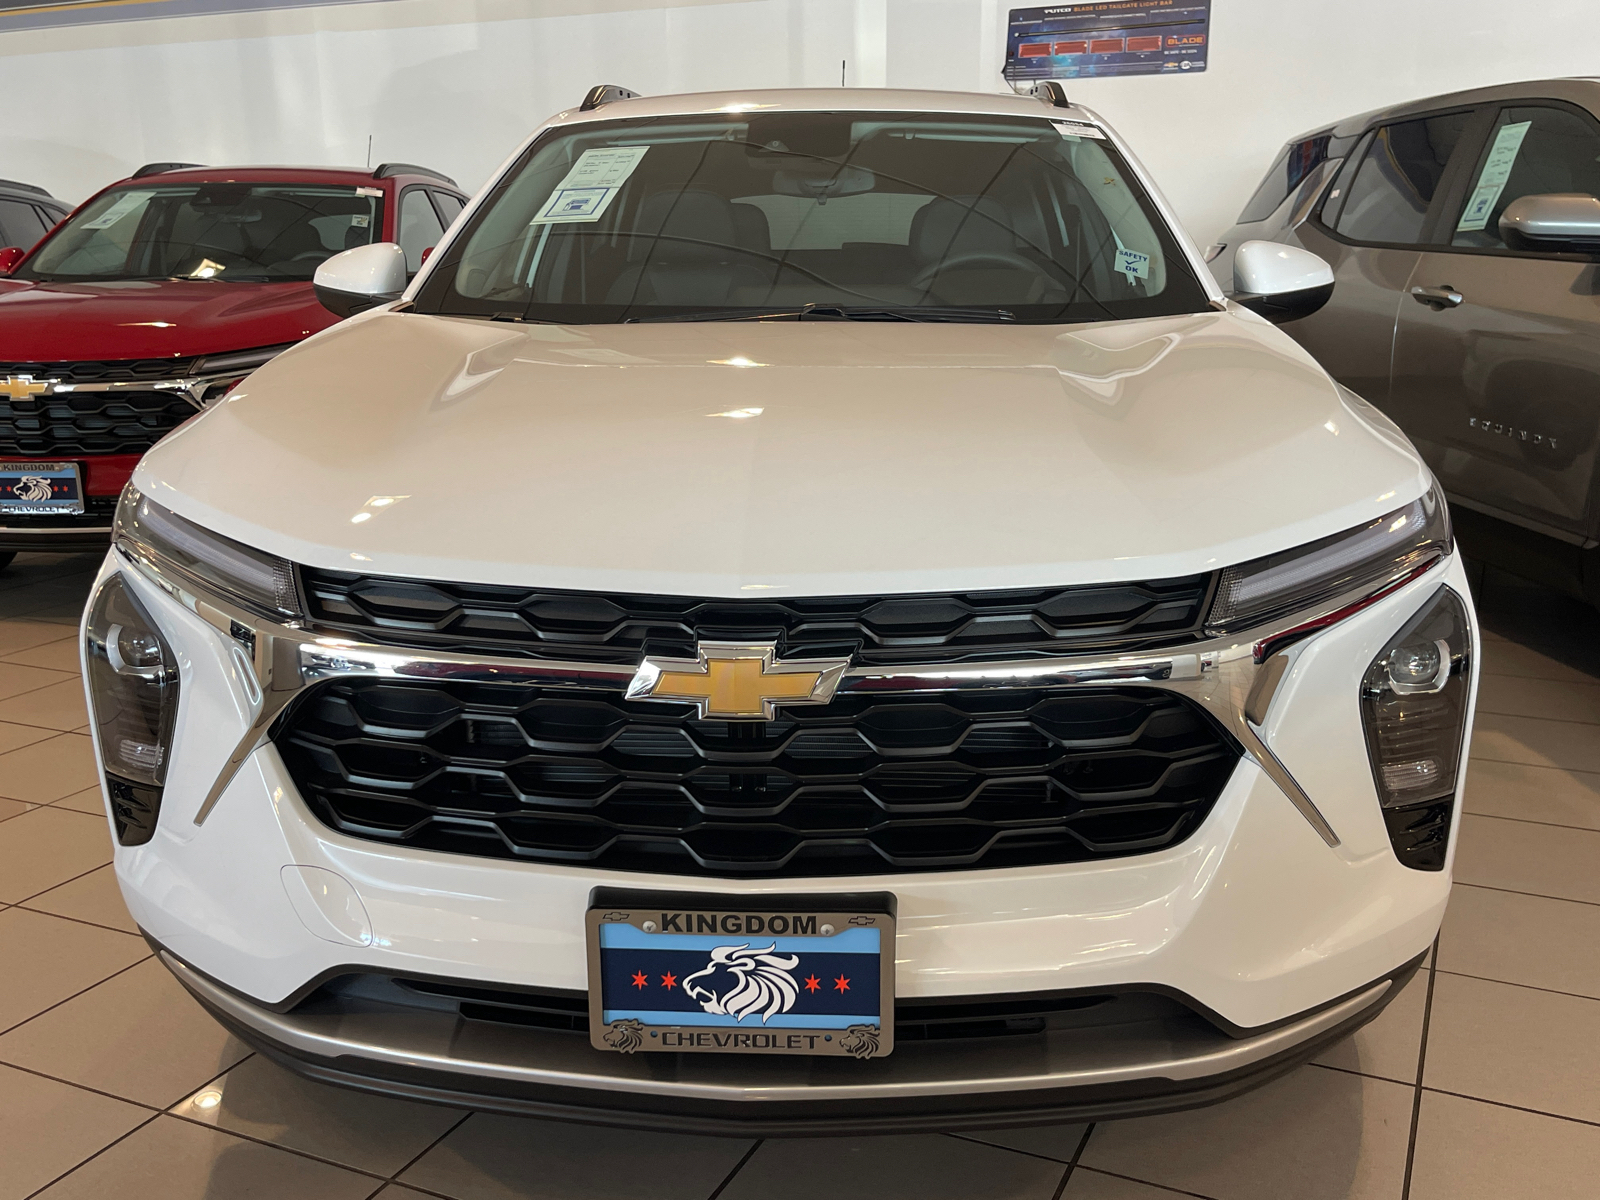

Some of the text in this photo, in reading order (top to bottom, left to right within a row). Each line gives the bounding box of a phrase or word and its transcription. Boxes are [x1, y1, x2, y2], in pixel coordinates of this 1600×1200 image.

[1167, 36, 1203, 45] BLADE
[1119, 251, 1147, 262] SAFETY
[1469, 417, 1557, 449] EQUINOX
[661, 912, 818, 935] KINGDOM
[661, 1031, 821, 1050] CHEVROLET
